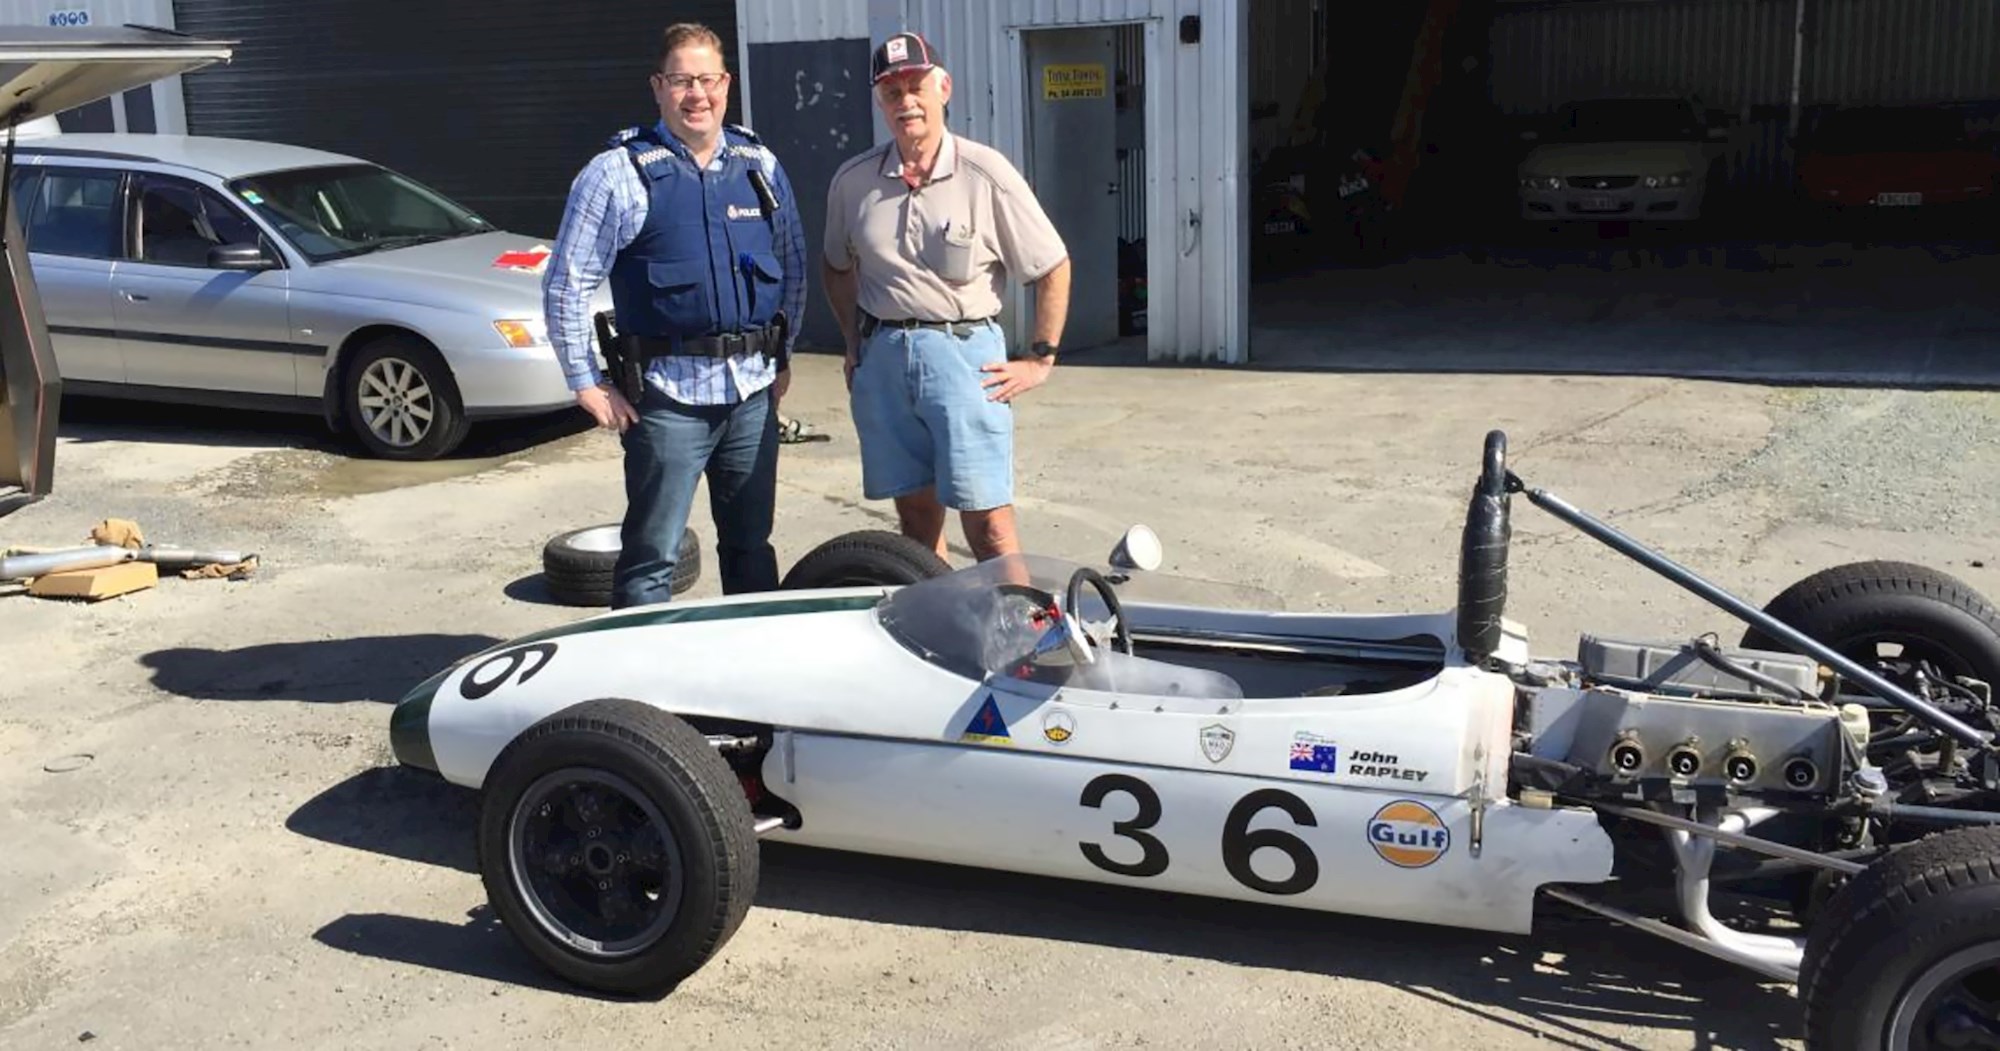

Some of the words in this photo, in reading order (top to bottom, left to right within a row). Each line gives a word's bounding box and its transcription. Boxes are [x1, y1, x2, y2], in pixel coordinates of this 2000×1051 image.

[738, 207, 761, 217] POLICE
[1349, 750, 1398, 764] John
[1349, 764, 1428, 782] RAPLEY
[1371, 822, 1446, 848] Gulf
